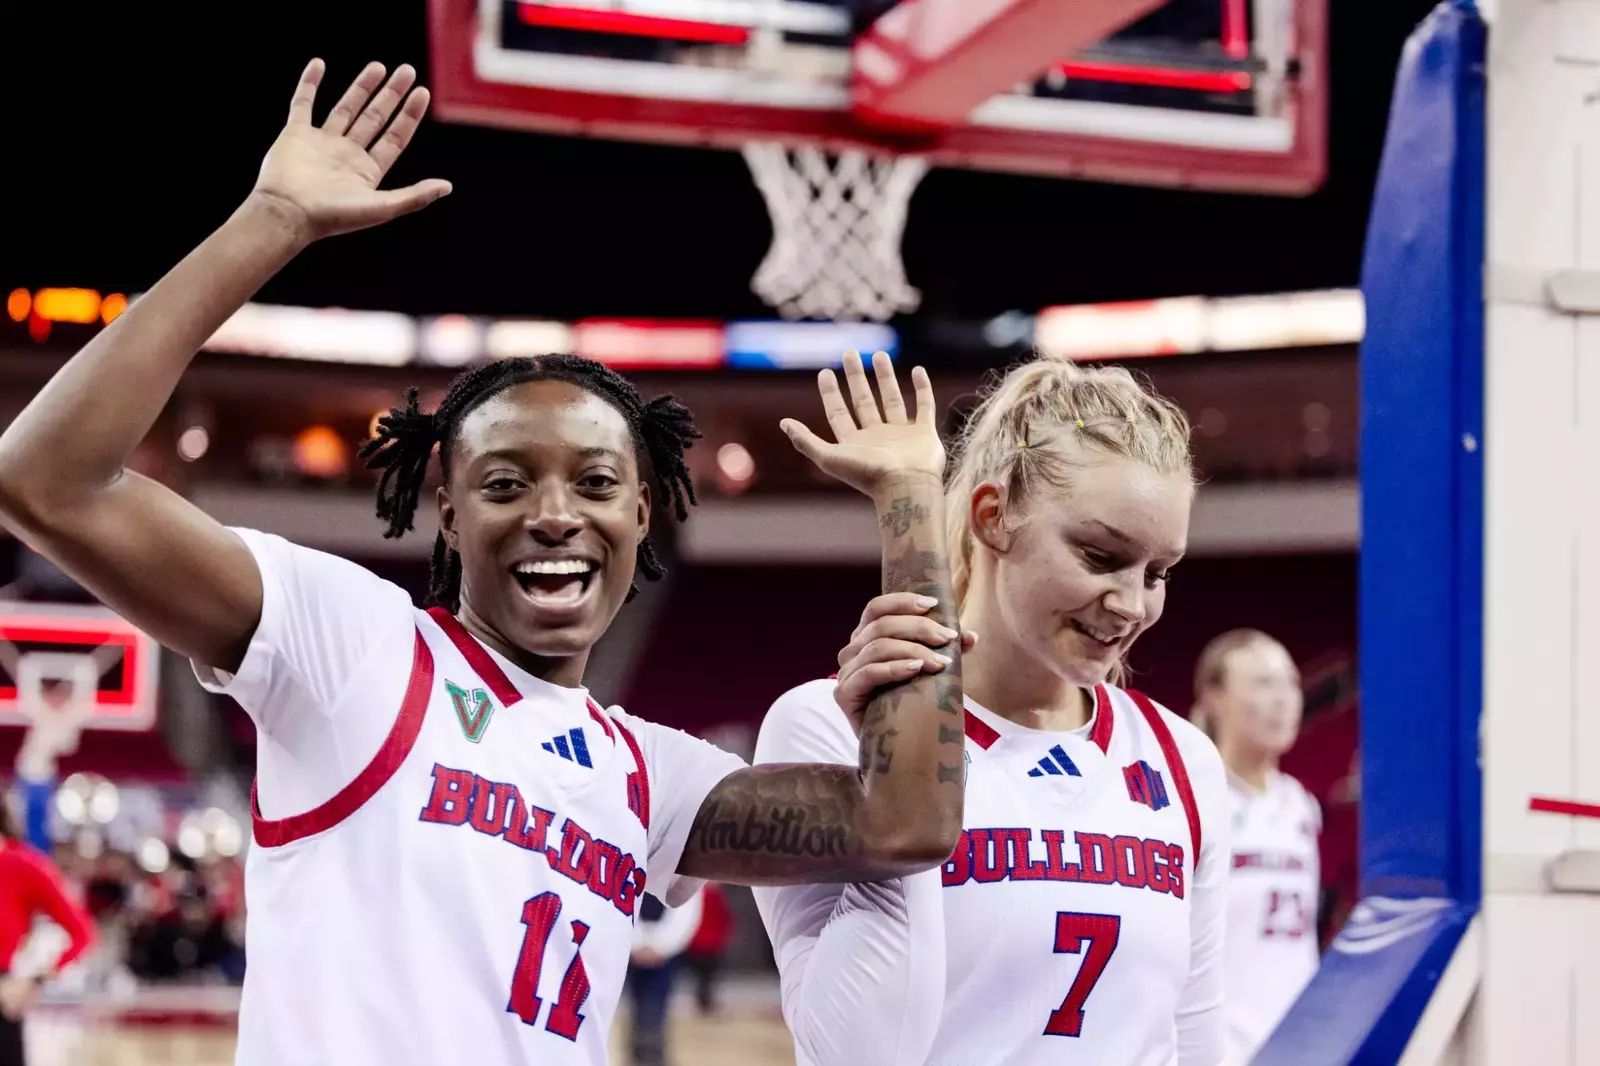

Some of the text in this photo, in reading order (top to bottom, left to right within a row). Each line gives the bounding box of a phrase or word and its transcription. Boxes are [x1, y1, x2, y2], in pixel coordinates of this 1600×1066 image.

[694, 800, 848, 857] Ambition
[941, 827, 1185, 900] BULLDOGS
[506, 891, 592, 1041] 11
[1042, 911, 1121, 1037] 7
